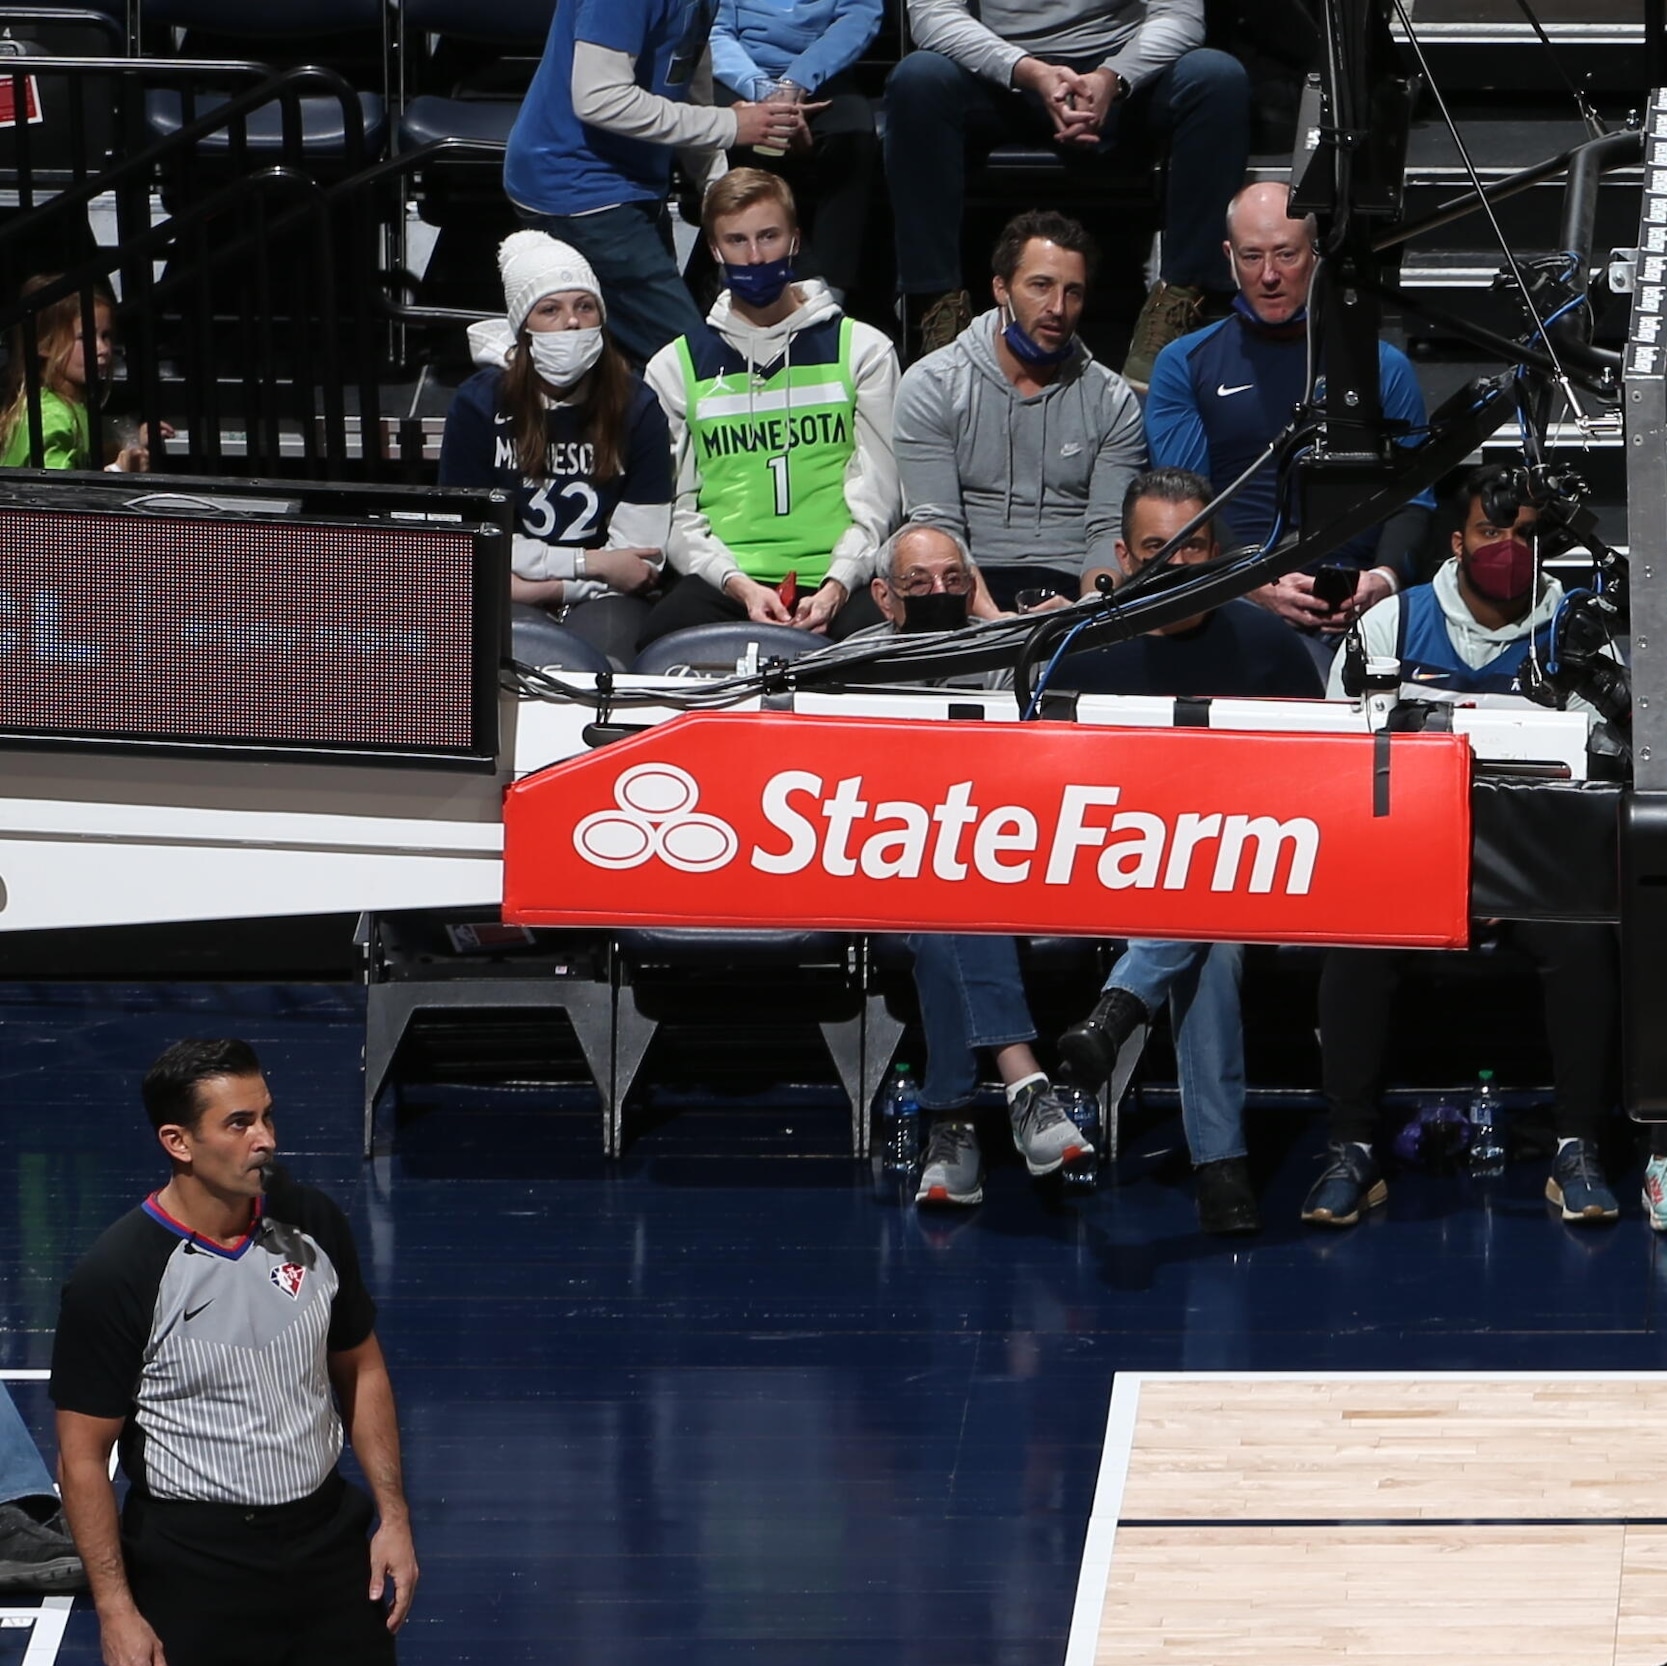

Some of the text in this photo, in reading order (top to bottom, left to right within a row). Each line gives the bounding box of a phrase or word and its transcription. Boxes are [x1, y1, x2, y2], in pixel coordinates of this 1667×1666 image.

[2, 27, 11, 38] 4
[702, 412, 847, 459] MINNESOTA
[522, 478, 599, 541] 32
[766, 454, 791, 517] 1
